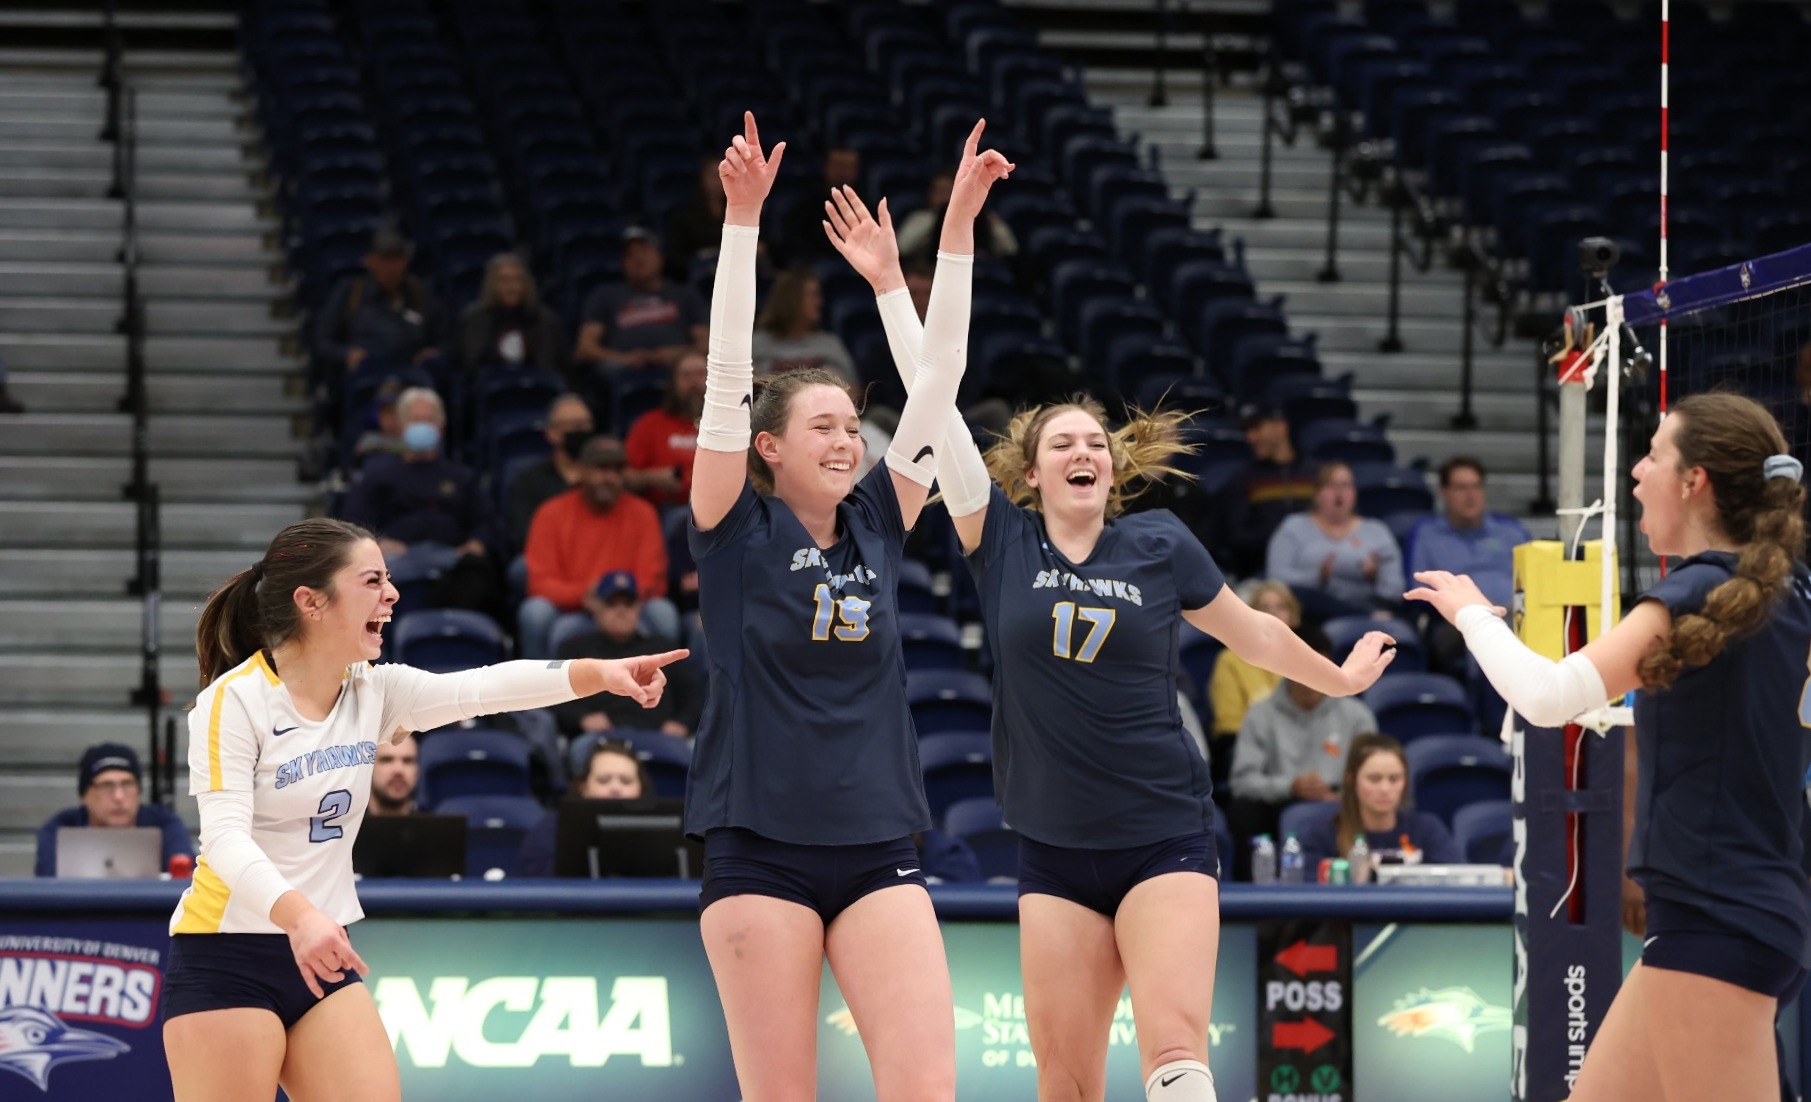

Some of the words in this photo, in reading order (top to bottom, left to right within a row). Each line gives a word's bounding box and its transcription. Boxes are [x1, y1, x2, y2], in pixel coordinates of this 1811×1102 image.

[812, 584, 872, 641] 19
[1052, 601, 1116, 663] 17
[309, 788, 352, 843] 2
[81, 939, 101, 957] OF
[103, 941, 160, 966] DENVER
[374, 976, 673, 1067] NCAA
[1266, 981, 1343, 1011] POSS
[1563, 965, 1589, 1042] sports
